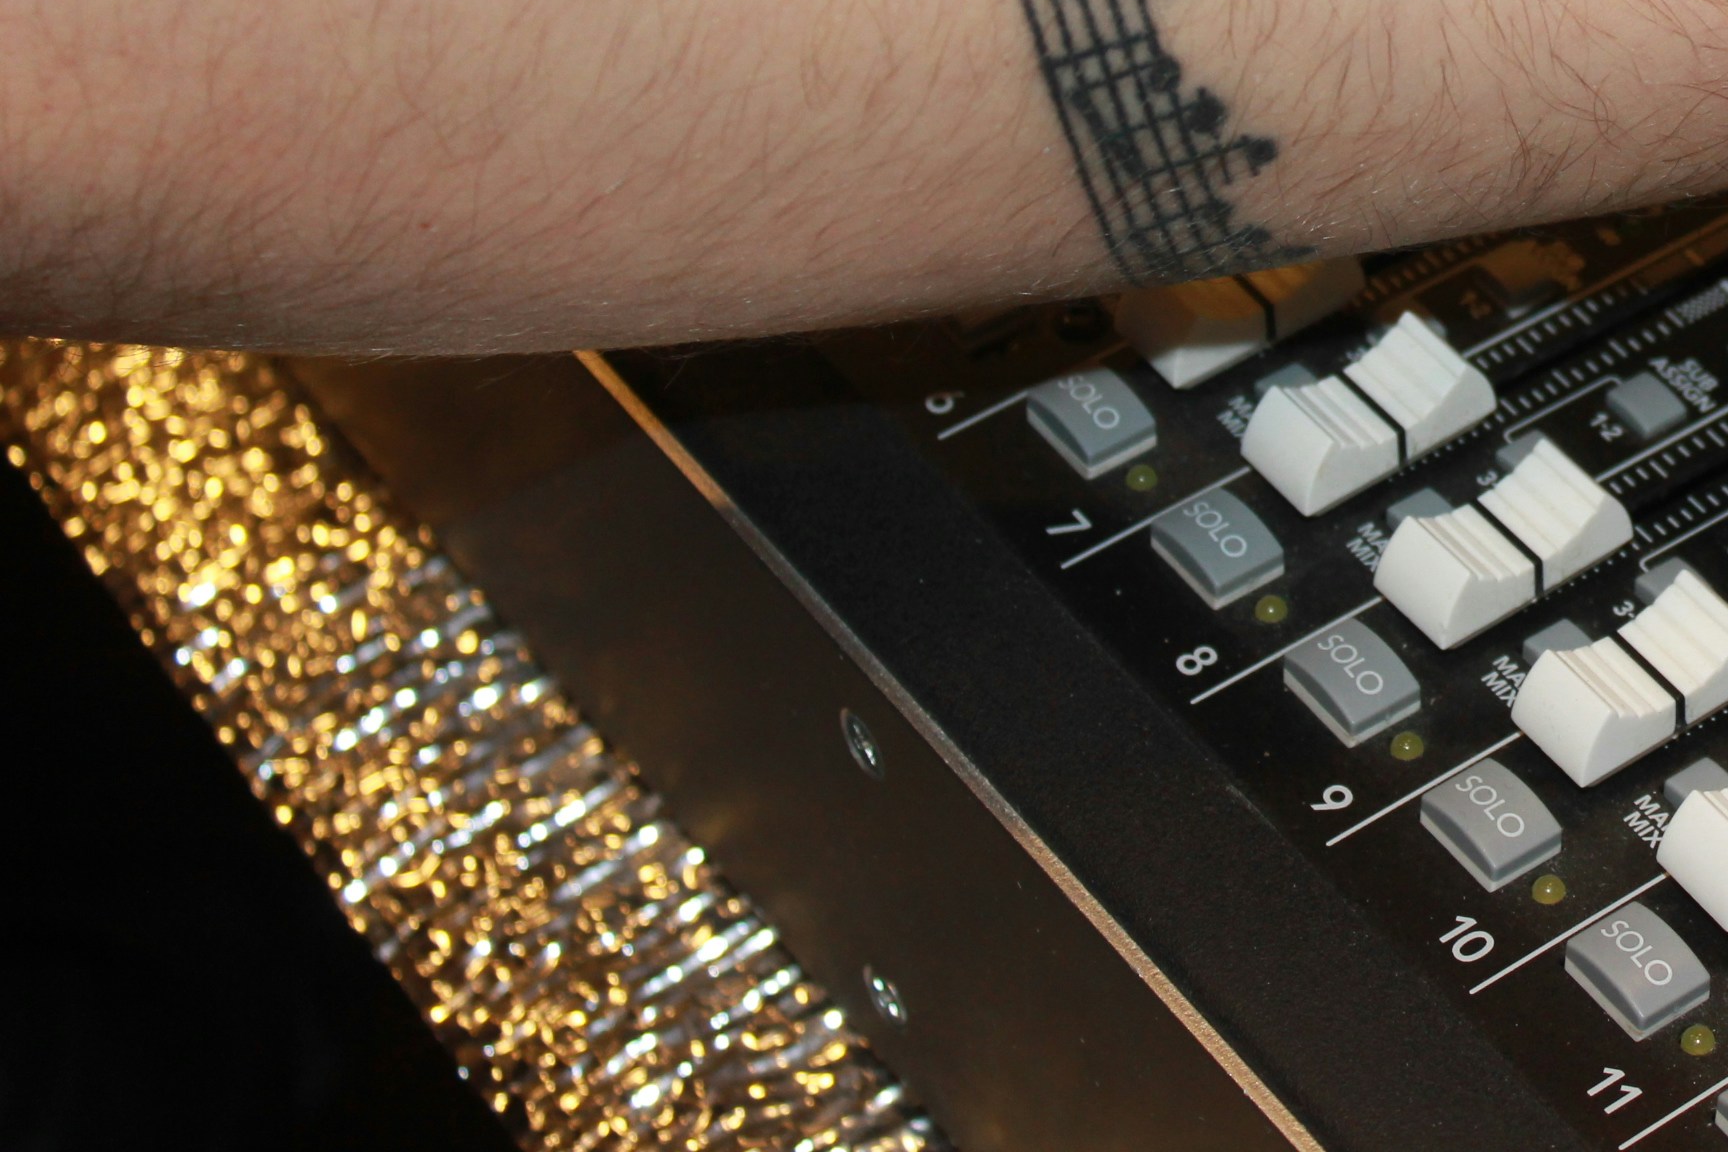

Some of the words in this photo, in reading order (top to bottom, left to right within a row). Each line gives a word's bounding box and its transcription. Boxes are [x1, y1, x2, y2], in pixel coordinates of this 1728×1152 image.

[1648, 357, 1716, 413] ASSIGN
[1678, 358, 1719, 392] SUB
[925, 391, 964, 415] 6
[1058, 375, 1120, 429] SOLO
[1590, 413, 1624, 442] 1-2
[1046, 508, 1092, 535] 7
[1183, 501, 1247, 558] SOLO
[1357, 522, 1391, 554] MA
[1612, 601, 1635, 618] 3-
[1176, 646, 1218, 676] 8
[1317, 634, 1383, 695] SOLO
[1492, 655, 1526, 687] MA
[1310, 784, 1353, 811] 9
[1455, 774, 1524, 837] SOLO
[1623, 811, 1663, 849] MIX
[1439, 915, 1494, 962] 10
[1600, 920, 1673, 985] SOLO
[1586, 1067, 1642, 1115] 11
